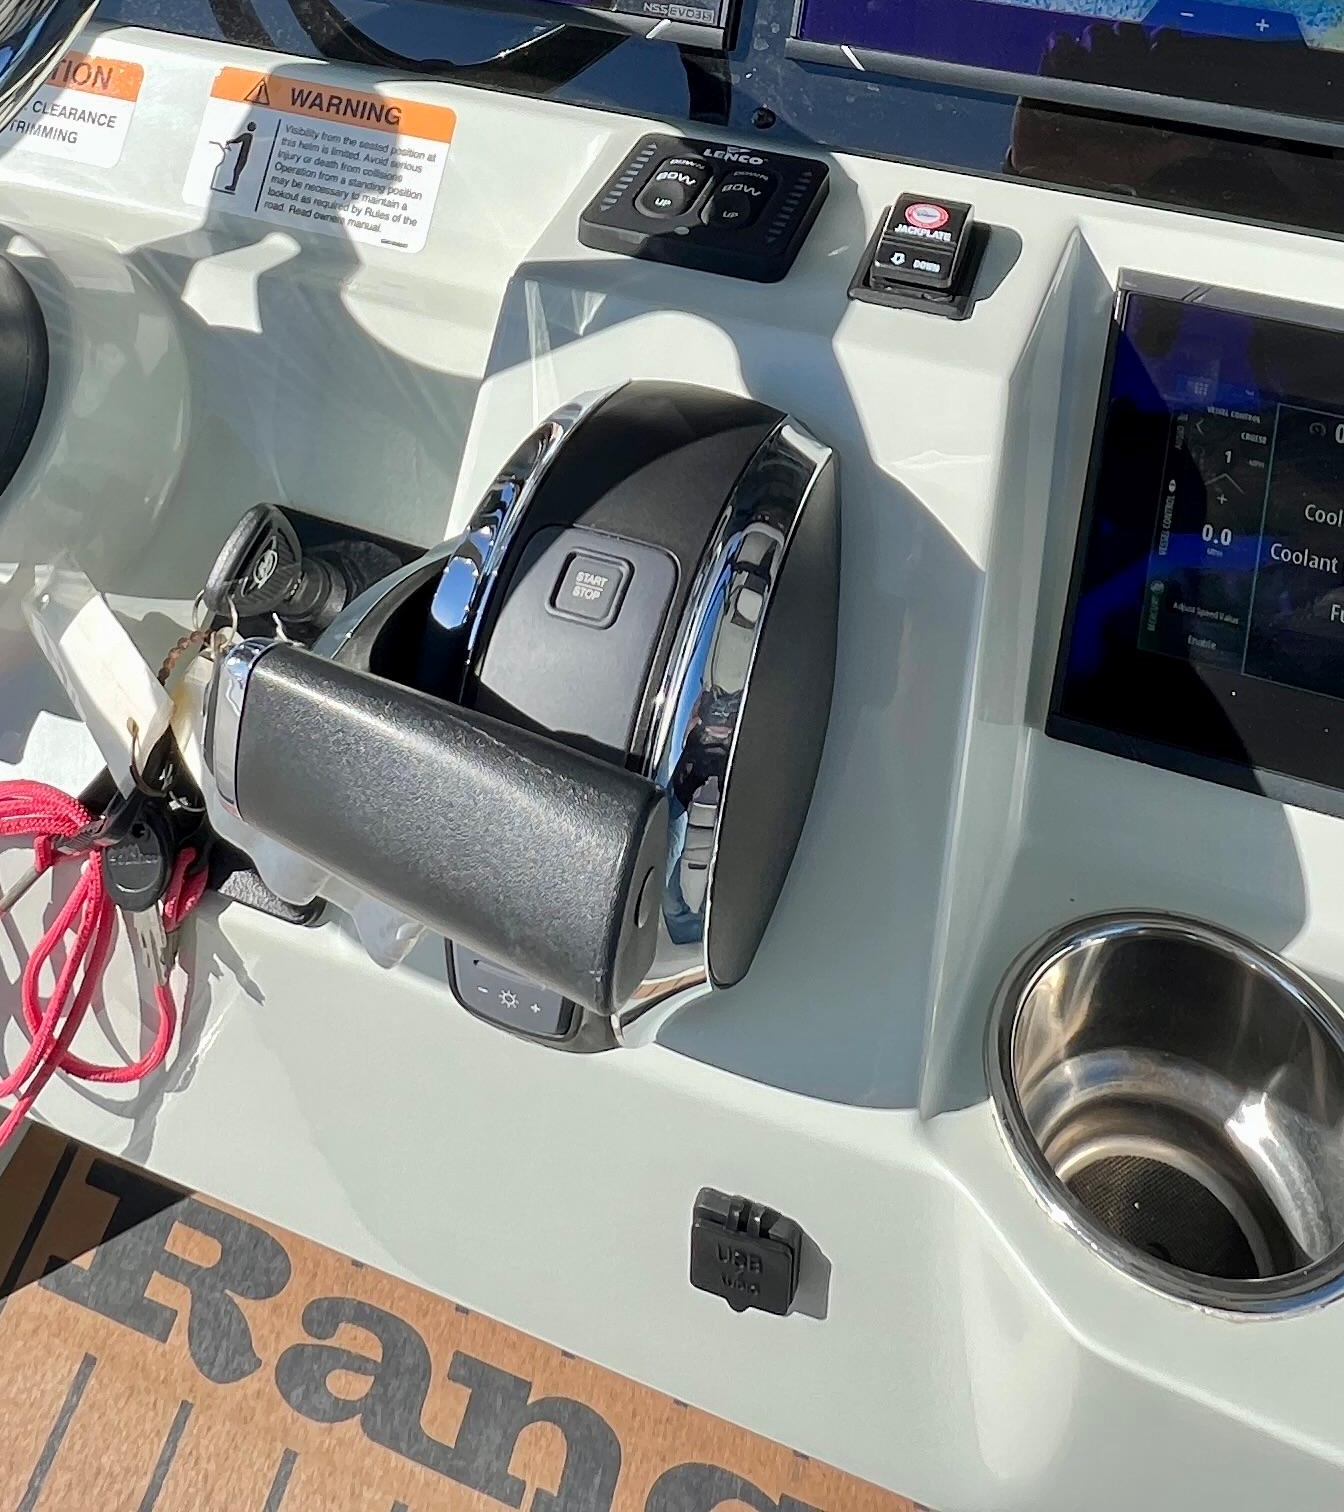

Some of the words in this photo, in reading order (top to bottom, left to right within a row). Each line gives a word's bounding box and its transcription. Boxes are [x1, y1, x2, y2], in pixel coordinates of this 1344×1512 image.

[644, 2, 668, 15] NSS
[32, 100, 117, 128] CLEARANCE
[290, 87, 402, 125] WARNING
[9, 120, 78, 144] TRIMMING
[285, 124, 319, 139] Visibility
[321, 131, 341, 142] from
[343, 134, 356, 145] the
[359, 138, 389, 152] seated
[390, 144, 425, 159] position
[281, 138, 296, 148] this
[298, 141, 320, 153] helm
[363, 153, 389, 166] Avoid
[391, 160, 423, 173] serious
[703, 147, 764, 165] LENCO
[314, 157, 338, 170] death
[341, 161, 361, 174] from
[274, 161, 316, 178] Operation
[318, 171, 338, 183] from
[348, 178, 385, 194] standing
[387, 186, 422, 200] position
[656, 171, 696, 185] BOW
[271, 176, 290, 188] may
[291, 178, 303, 188] be
[305, 183, 349, 200] necessary
[362, 194, 400, 210] maintain
[721, 184, 761, 196] BOW
[268, 188, 299, 201] lookout
[313, 197, 350, 212] required
[351, 204, 362, 216] by
[364, 207, 390, 221] Rules
[403, 216, 417, 227] the
[655, 198, 672, 207] UP
[289, 205, 312, 218] Read
[347, 218, 382, 233] manual.
[895, 223, 952, 241] JACKPLATE
[913, 259, 940, 273] DOWN
[1225, 450, 1232, 463] 1
[1202, 524, 1232, 545] 0.0
[1270, 543, 1338, 574] Coolant
[576, 571, 608, 587] START
[572, 586, 601, 600] STOP
[1187, 635, 1216, 650] Enable
[718, 1242, 762, 1274] USB
